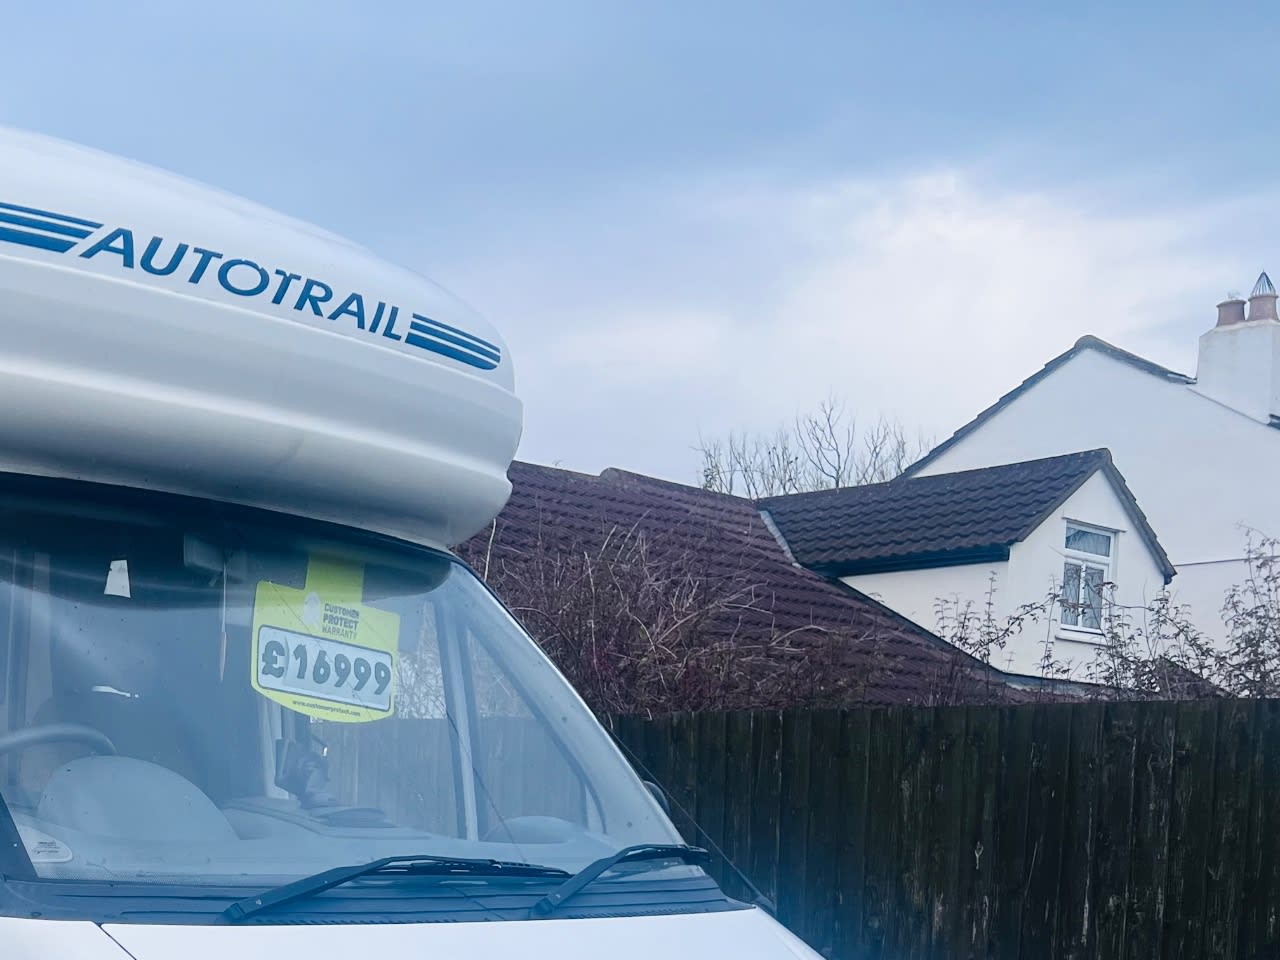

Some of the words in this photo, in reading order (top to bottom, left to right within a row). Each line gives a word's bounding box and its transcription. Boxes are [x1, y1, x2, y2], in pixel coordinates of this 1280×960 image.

[80, 228, 404, 341] AUTOTRAIL
[321, 624, 357, 640] WARRANTY
[322, 613, 359, 632] PROTECT
[261, 640, 391, 695] £16999
